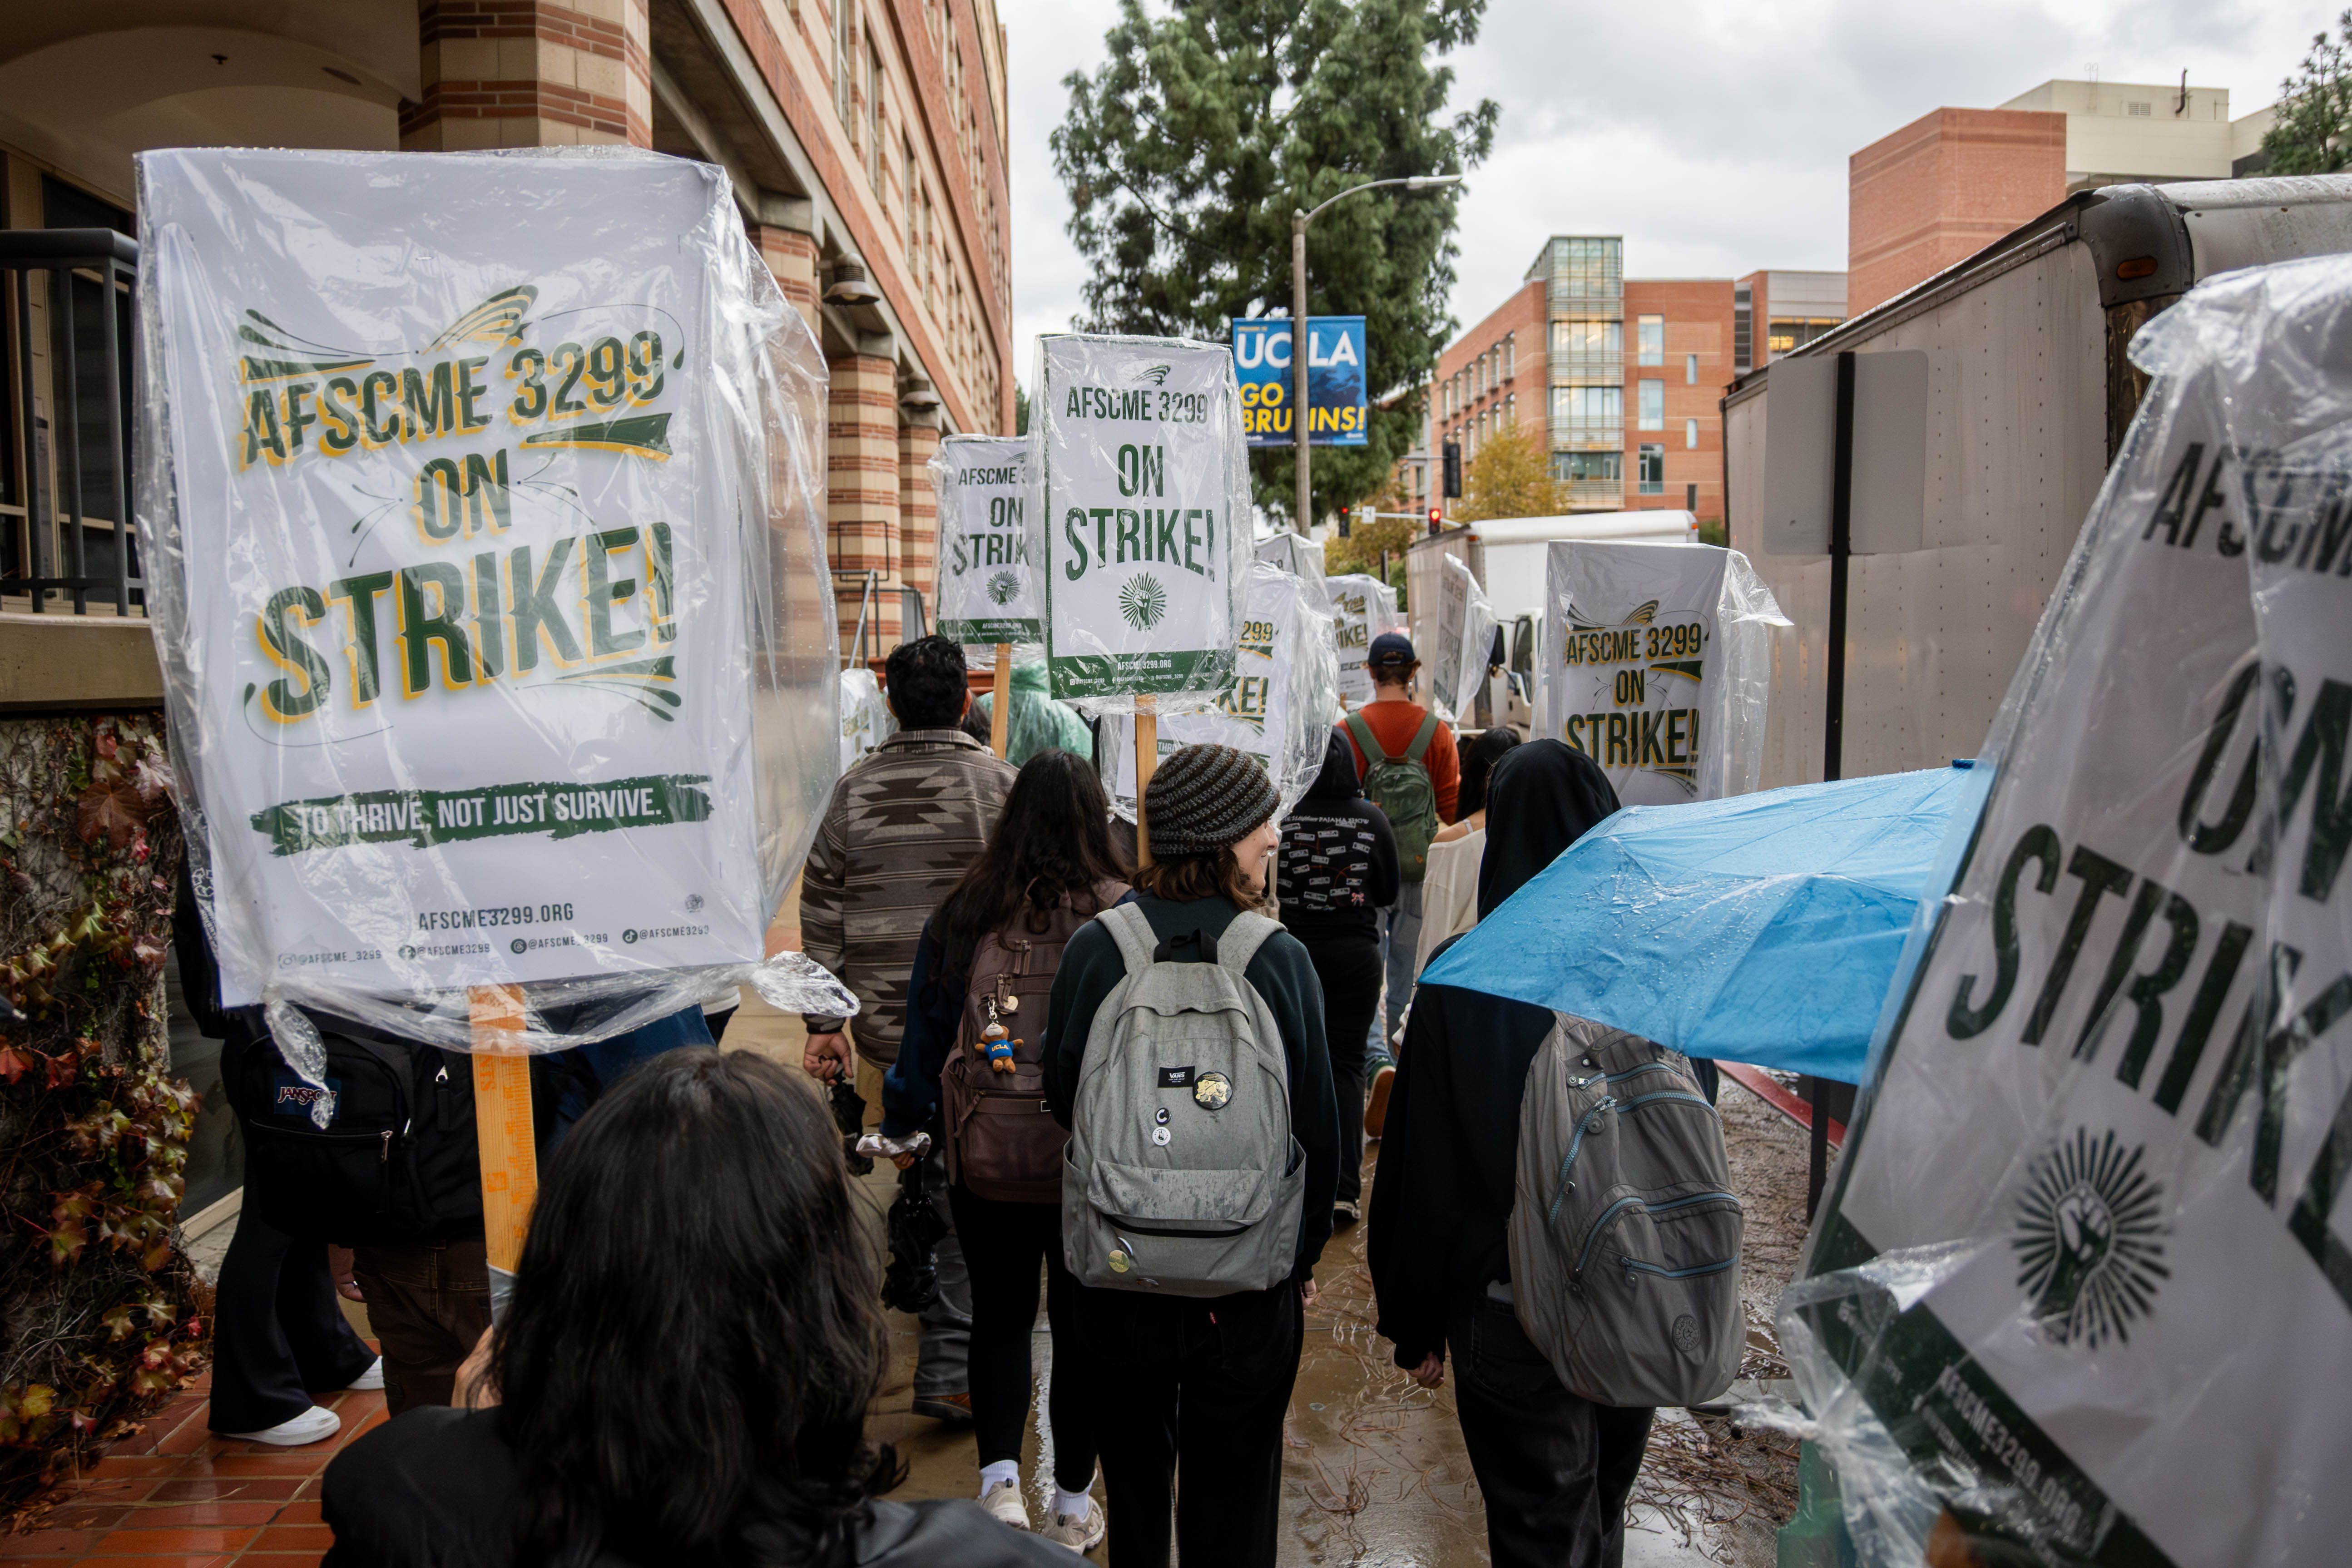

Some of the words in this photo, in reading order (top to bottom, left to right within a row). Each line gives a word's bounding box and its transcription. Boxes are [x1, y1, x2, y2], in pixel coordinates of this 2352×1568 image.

[1236, 331, 1358, 369] UCLA
[238, 355, 492, 471] AFSCME
[509, 329, 665, 424] 3299
[1066, 386, 1151, 421] AFSCME
[1158, 391, 1208, 424] 3299
[1239, 382, 1284, 407] GO
[1243, 406, 1365, 433] BRUINS!
[959, 466, 1017, 485] AFSCME
[1118, 444, 1164, 497] ON
[413, 448, 513, 542] ON
[990, 496, 1024, 527] ON
[1065, 507, 1216, 582] STRIKE!
[256, 522, 677, 723] STRIKE!
[1565, 628, 1641, 665] AFSCME
[1646, 623, 1702, 659] 3299
[1615, 669, 1645, 706] ON
[1565, 708, 1699, 768] STRIKE!
[296, 806, 329, 836] TO
[334, 800, 432, 834] THRIVE,
[437, 796, 486, 828] NOT
[492, 793, 548, 825] JUST
[555, 787, 661, 822] SURVIVE.
[419, 903, 574, 930] AFSCME3299.ORG
[639, 925, 709, 940] @AFSCME3299
[991, 1043, 1009, 1052] UCLA
[277, 1086, 337, 1105] JANSPOT
